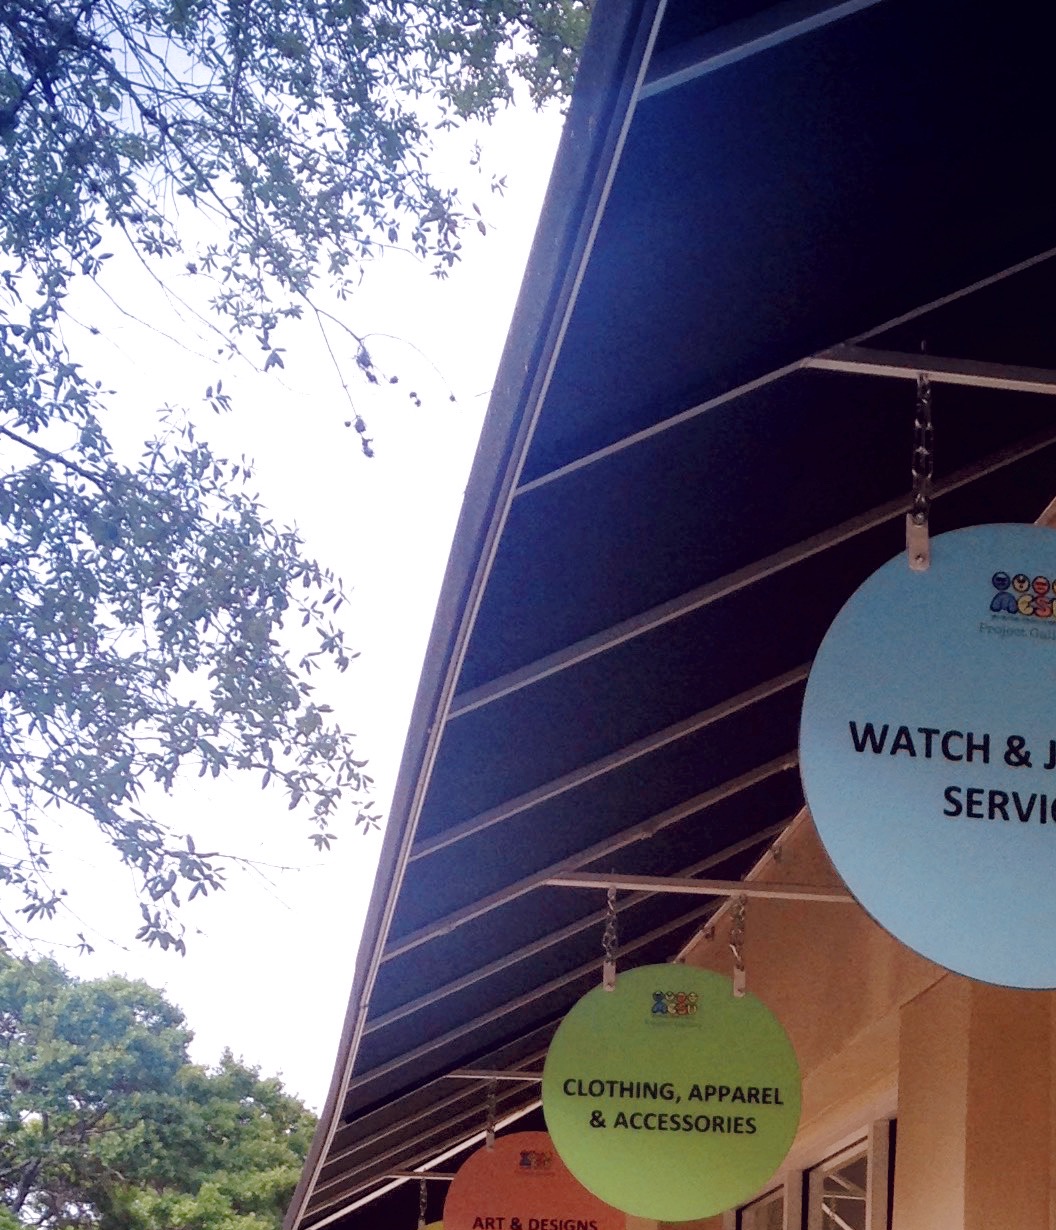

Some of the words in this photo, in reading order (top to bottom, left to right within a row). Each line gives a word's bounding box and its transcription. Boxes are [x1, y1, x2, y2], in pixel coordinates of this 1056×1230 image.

[849, 720, 990, 763] WATCH
[1004, 735, 1032, 768] &
[563, 1078, 682, 1104] CLOTHING,
[688, 1083, 784, 1105] APPAREL
[589, 1110, 605, 1128] &
[614, 1111, 757, 1134] ACCESSORIES
[473, 1217, 504, 1230] ART
[510, 1217, 523, 1230] &
